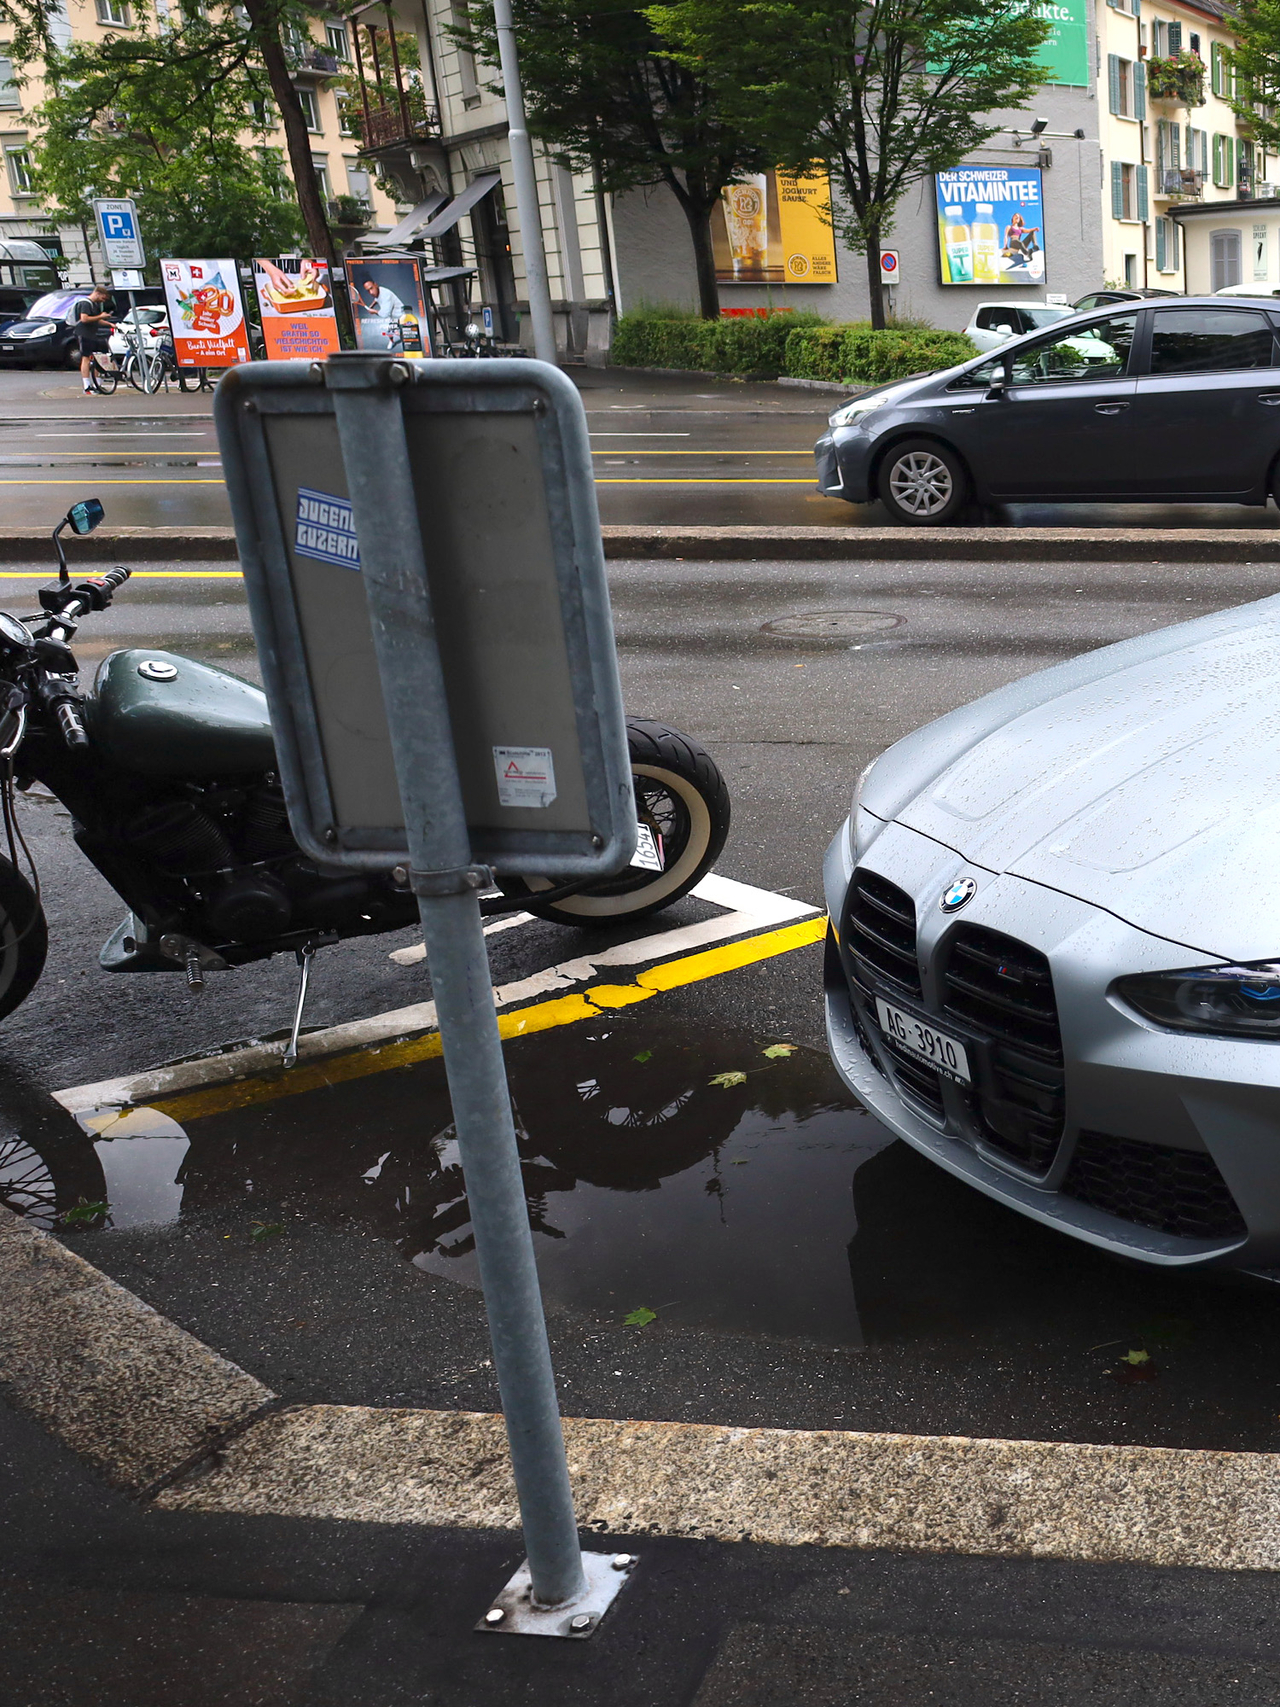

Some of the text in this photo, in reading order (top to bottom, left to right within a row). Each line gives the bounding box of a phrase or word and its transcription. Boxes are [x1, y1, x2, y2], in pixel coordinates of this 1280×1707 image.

[939, 170, 1008, 182] DER SCHWEIZER
[939, 181, 1039, 203] VITAMINTEE
[106, 203, 123, 211] ZONE
[886, 1006, 957, 1069] AG 3910
